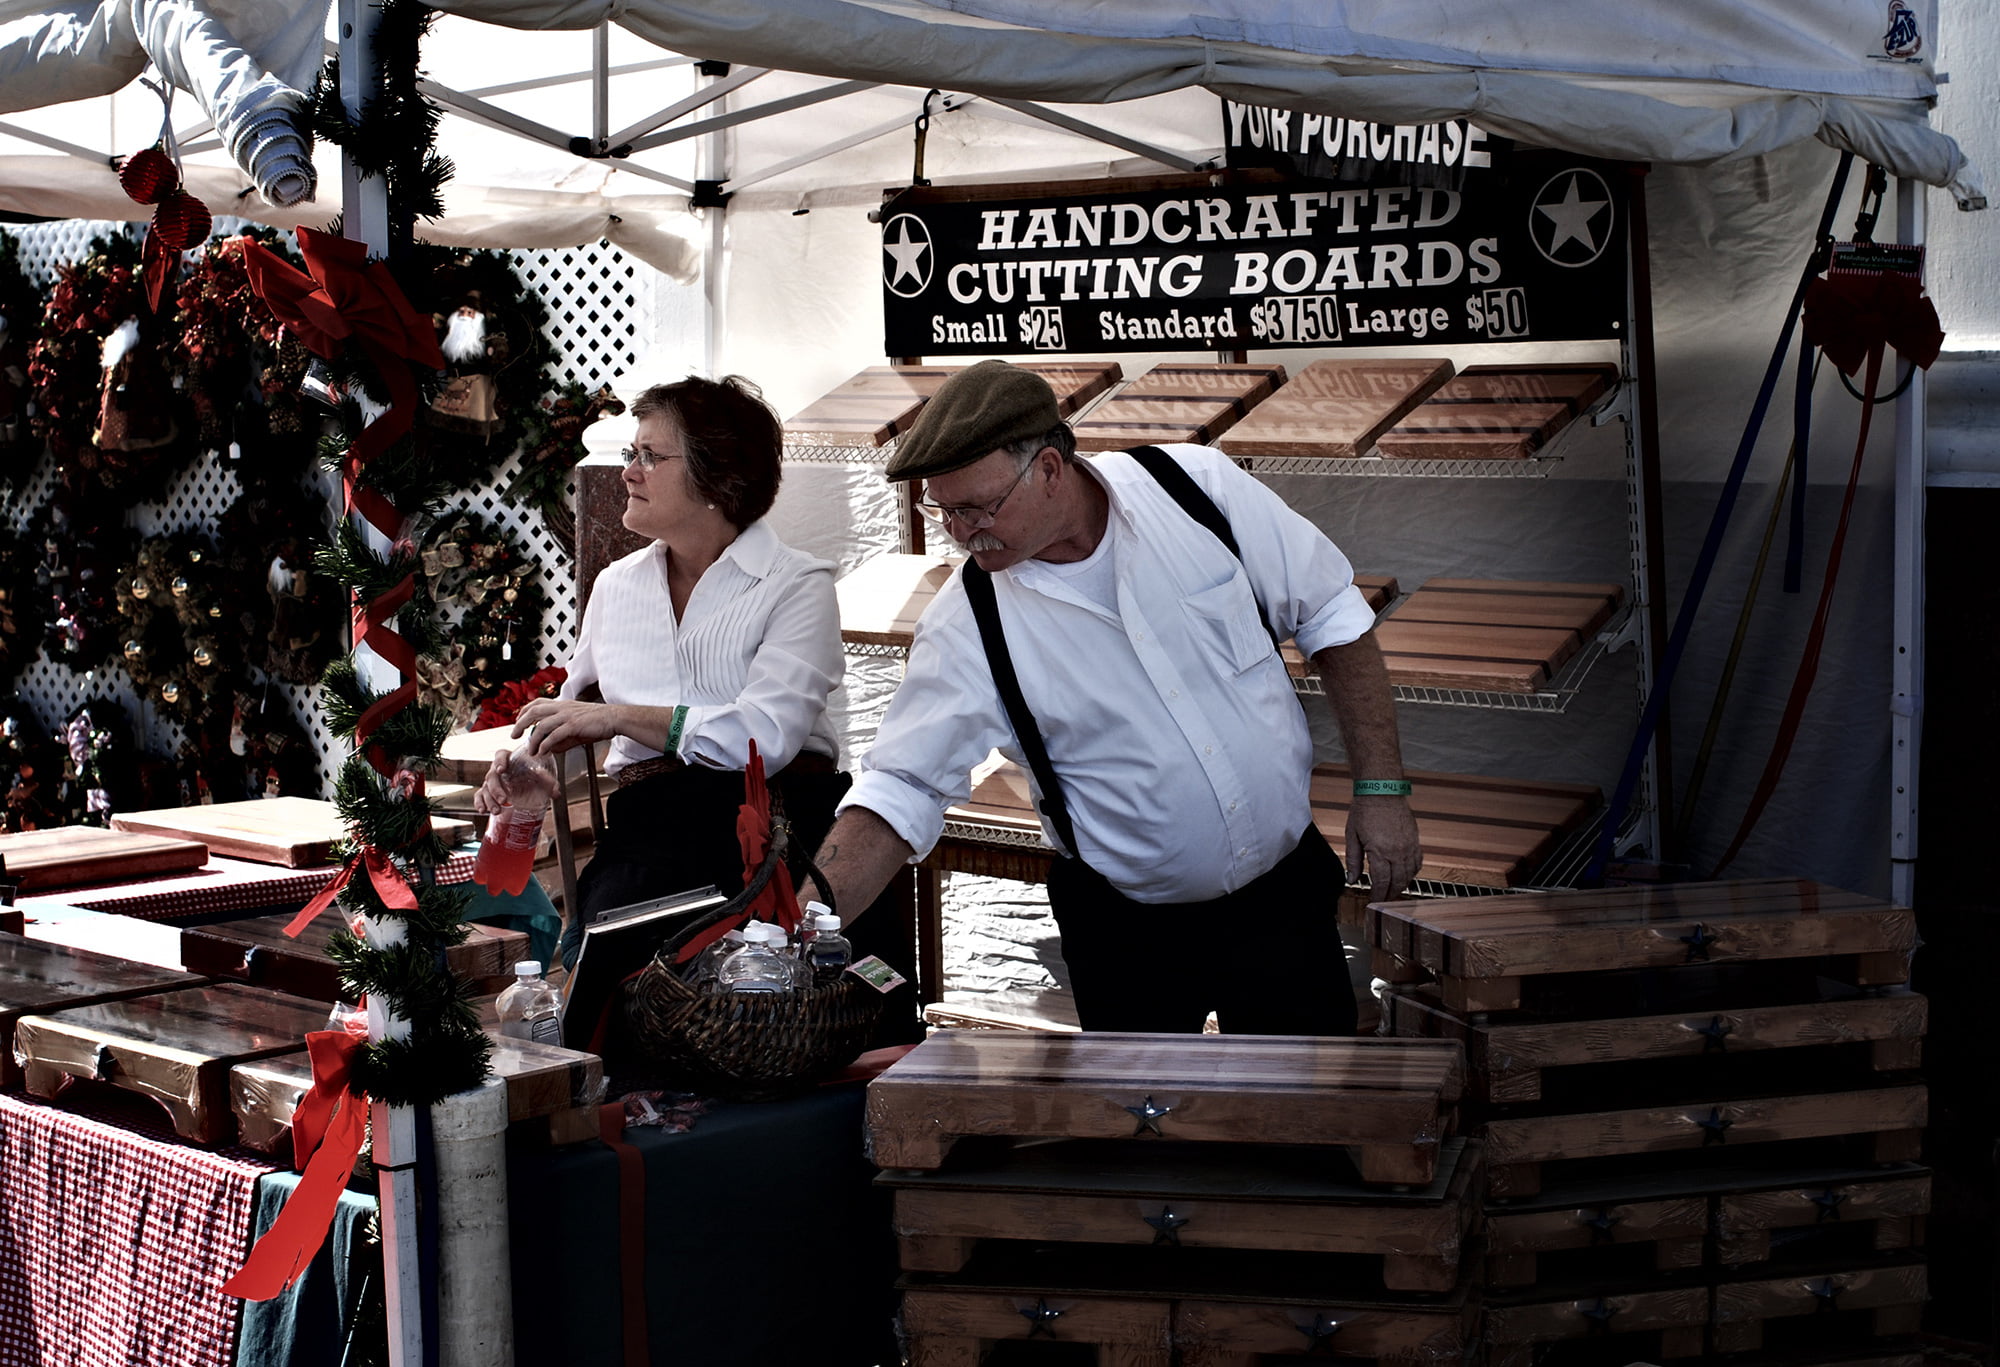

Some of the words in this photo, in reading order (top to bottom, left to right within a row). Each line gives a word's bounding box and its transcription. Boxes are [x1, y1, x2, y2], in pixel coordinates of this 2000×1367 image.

[1226, 99, 1293, 153] YOR
[1299, 112, 1492, 169] PURCHASE
[977, 186, 1463, 251] HANDCRAFTED
[947, 254, 1204, 304] CUTTING
[1229, 236, 1502, 296] BOARDS
[932, 313, 1008, 344] Small
[1018, 306, 1065, 350] $25
[1099, 307, 1238, 341] Standard
[1345, 302, 1450, 338] Large
[1465, 287, 1530, 338] $50
[1383, 782, 1398, 792] The
